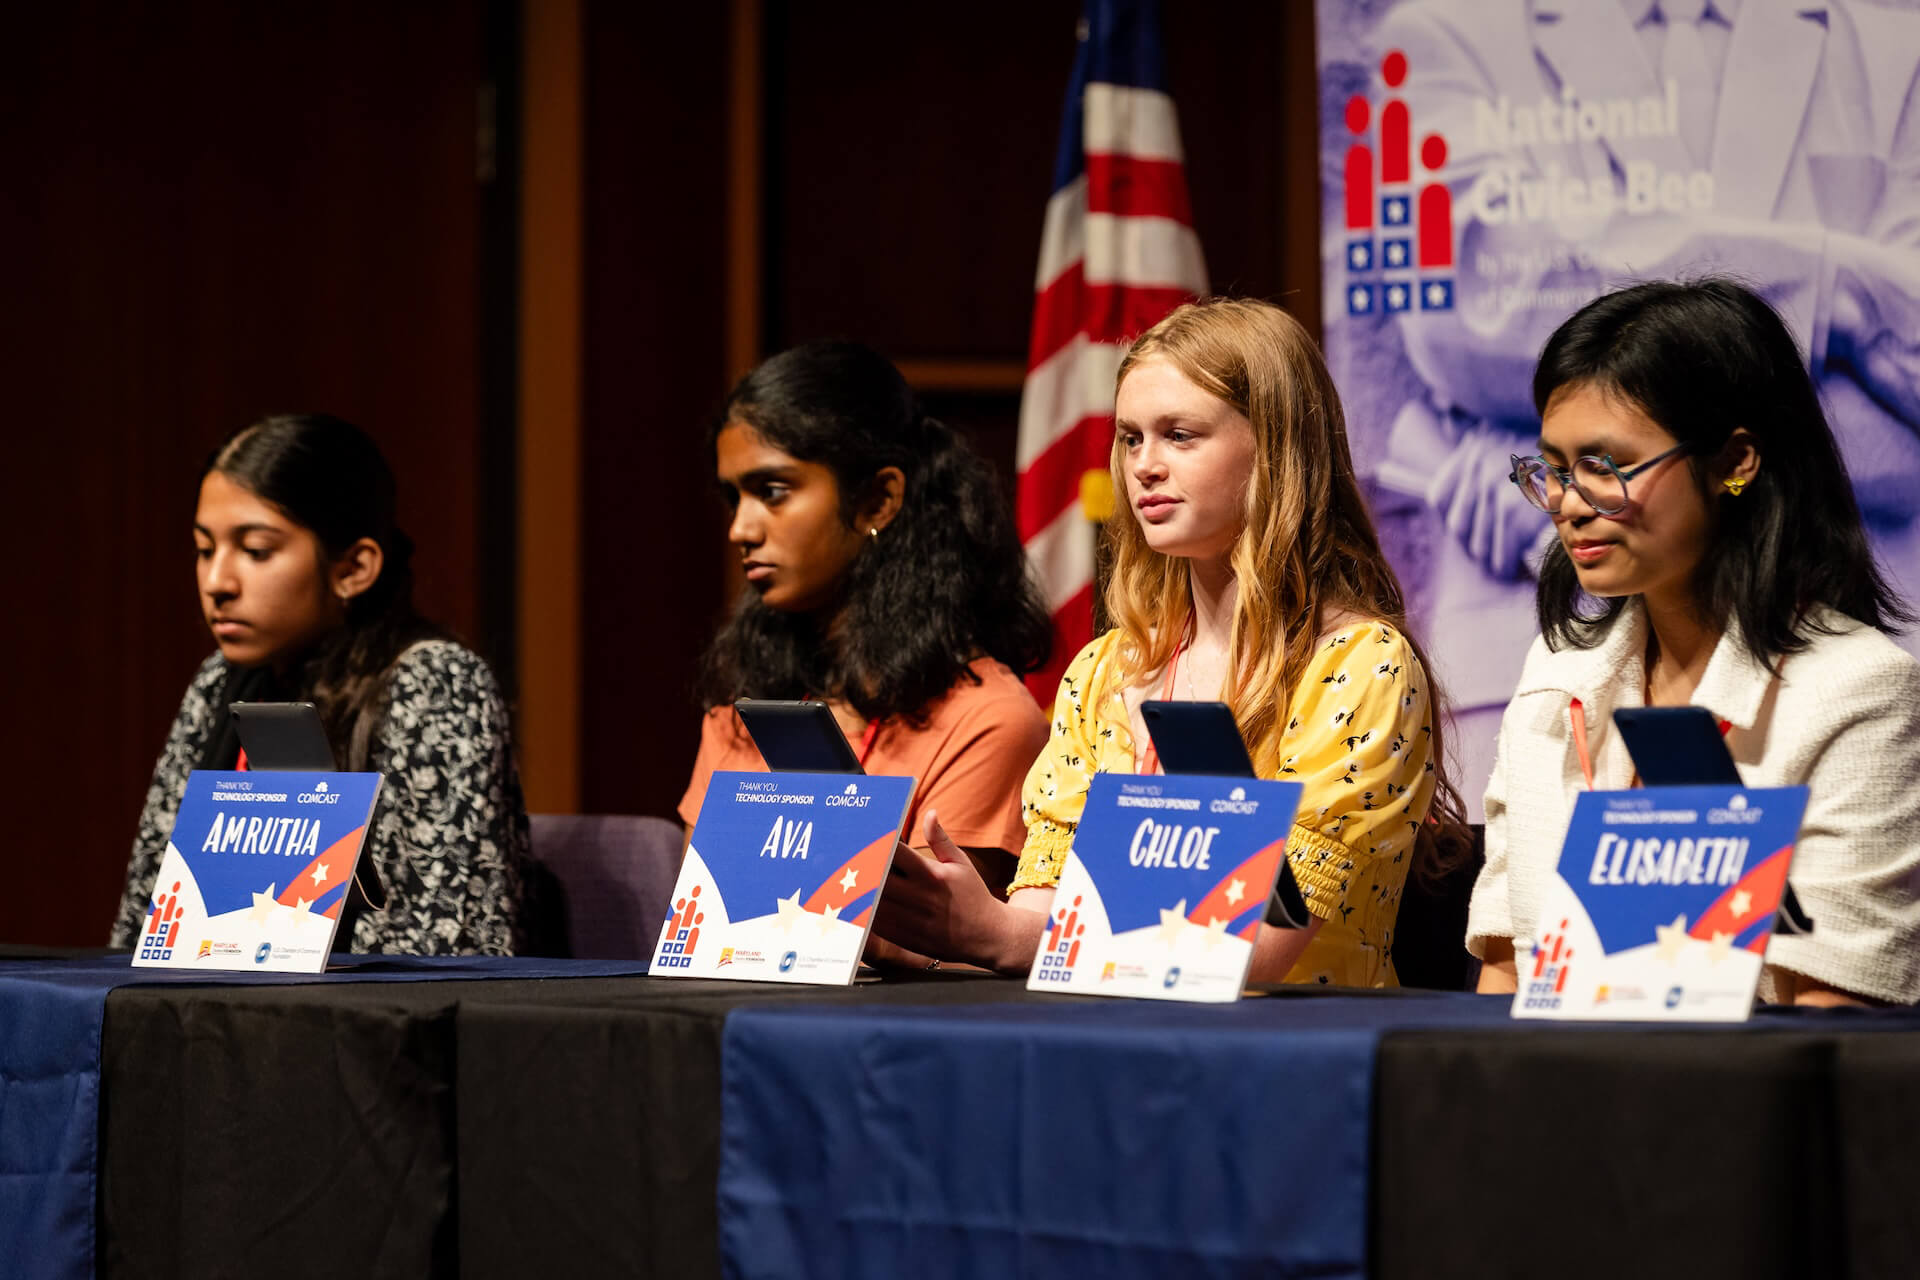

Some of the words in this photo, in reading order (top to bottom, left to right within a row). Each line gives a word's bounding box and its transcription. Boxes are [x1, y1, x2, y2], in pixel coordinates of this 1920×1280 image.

[1474, 79, 1678, 146] National
[1473, 160, 1616, 225] Civics
[1626, 160, 1714, 213] Bee
[212, 792, 256, 802] TECHNOLOGY
[256, 793, 288, 803] SPONSOR
[297, 793, 341, 804] COMCAST
[735, 793, 782, 803] TECHNOLOGY
[782, 795, 814, 805] SPONSOR
[739, 782, 762, 791] THANK
[762, 783, 778, 792] YOU
[825, 795, 871, 808] COMCAST
[1210, 799, 1259, 815] COMCAST
[202, 812, 321, 856] AMRUTHA
[760, 815, 813, 860] AVA
[1129, 817, 1220, 870] CHLOE
[1588, 833, 1749, 886] ELISABETH
